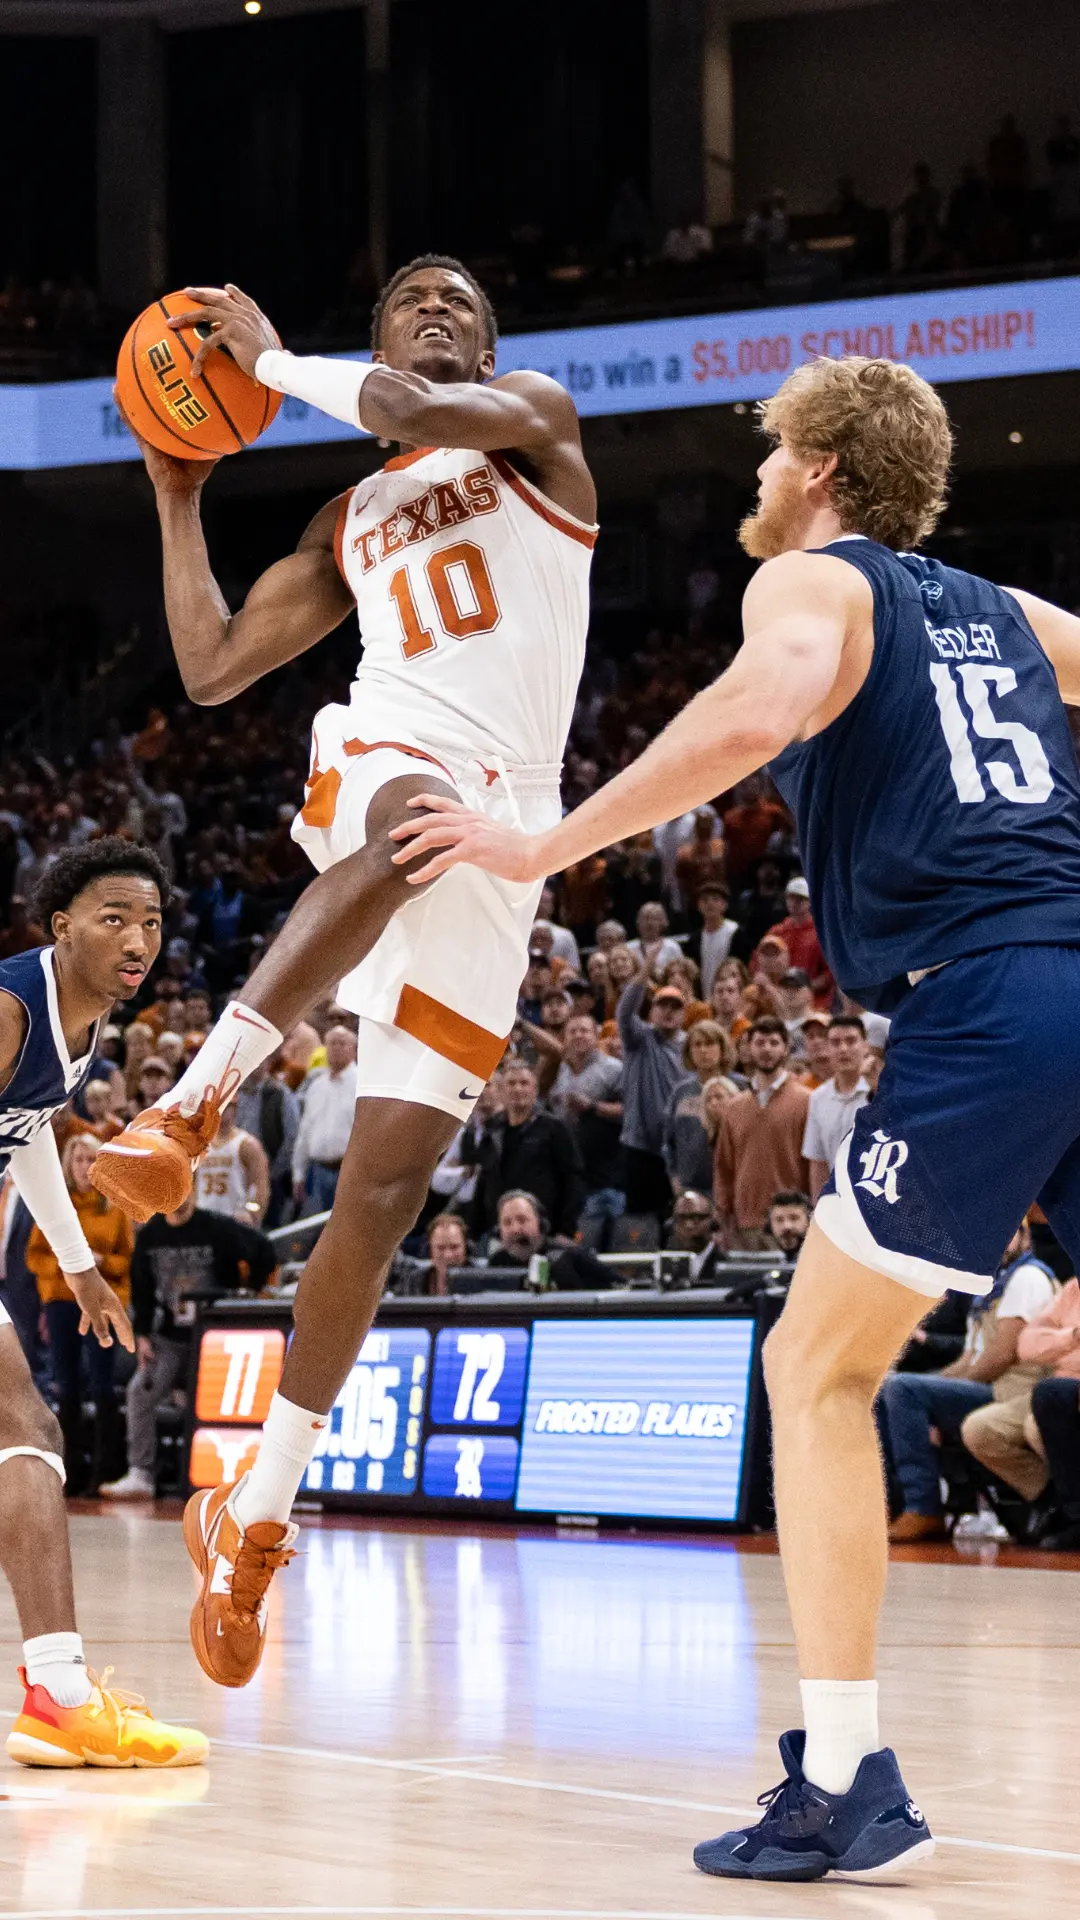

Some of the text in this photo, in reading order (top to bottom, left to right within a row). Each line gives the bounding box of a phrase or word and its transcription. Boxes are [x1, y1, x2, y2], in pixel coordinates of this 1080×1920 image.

[603, 349, 656, 388] win
[664, 354, 683, 384] a
[801, 309, 1036, 361] SCHOLARSHIP!
[351, 464, 501, 575] TEXAS
[388, 539, 502, 662] 10
[929, 662, 1055, 804] 15
[313, 1366, 400, 1459] :05
[453, 1334, 505, 1421] 72
[534, 1399, 737, 1439] FROSTED FLAKES
